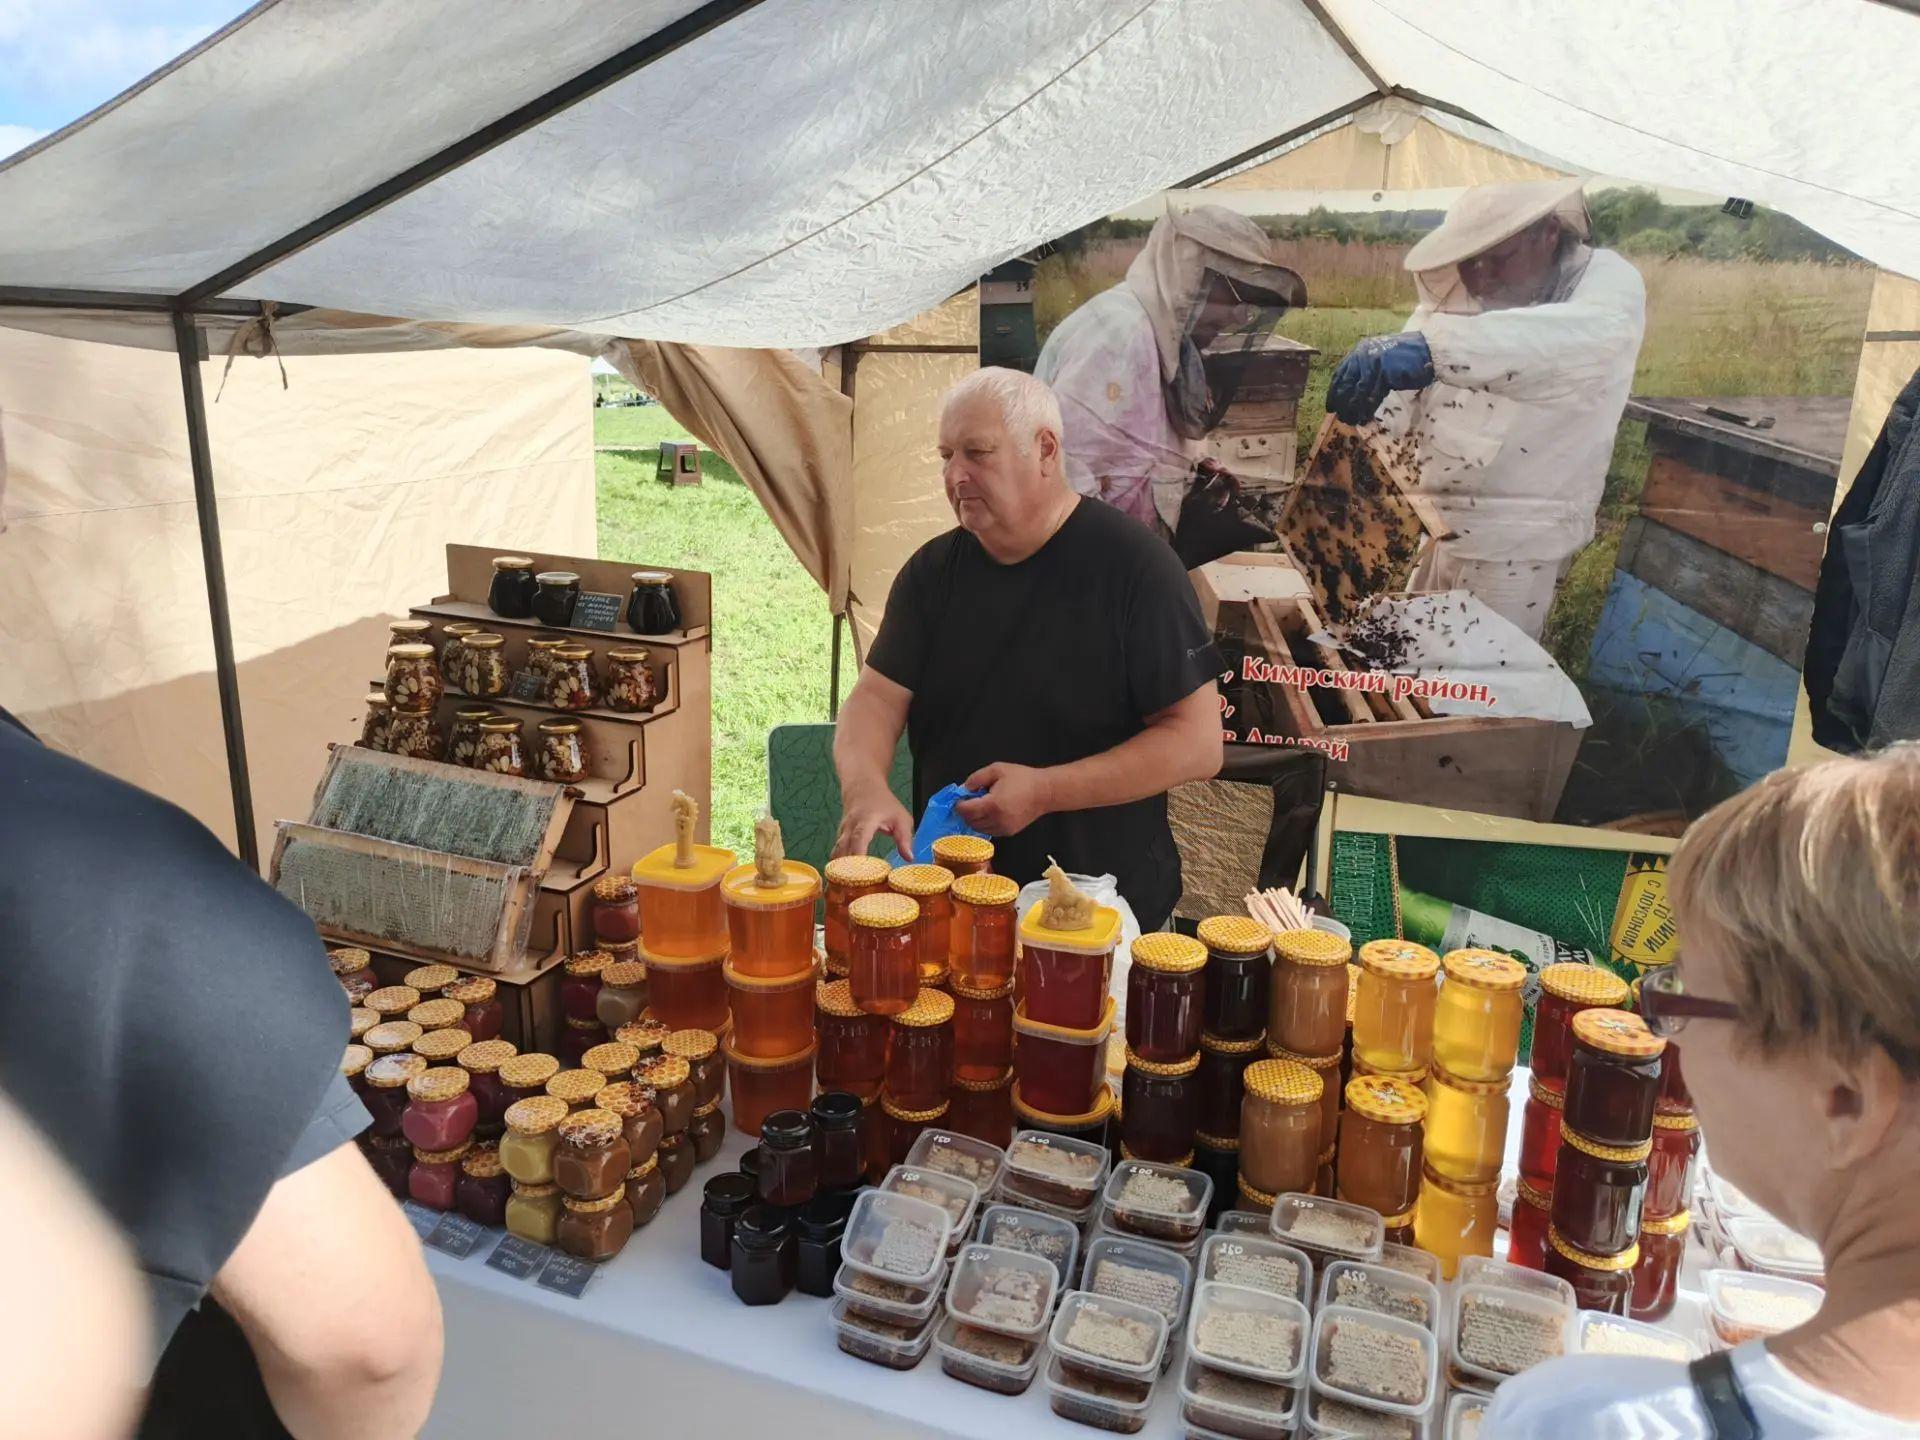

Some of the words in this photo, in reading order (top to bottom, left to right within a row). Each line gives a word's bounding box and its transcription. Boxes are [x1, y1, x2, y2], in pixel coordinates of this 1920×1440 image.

[1242, 656, 1386, 693] Кимрский
[1392, 674, 1498, 709] район,
[1648, 880, 1661, 888] С
[1621, 890, 1656, 948] ЛОУСОНОМ
[1029, 1136, 1050, 1144] 200
[1129, 1166, 1153, 1175] 200
[902, 1172, 920, 1181] 150
[1292, 1199, 1314, 1208] 250
[1219, 1242, 1244, 1255] 250
[1343, 1269, 1367, 1282] 250
